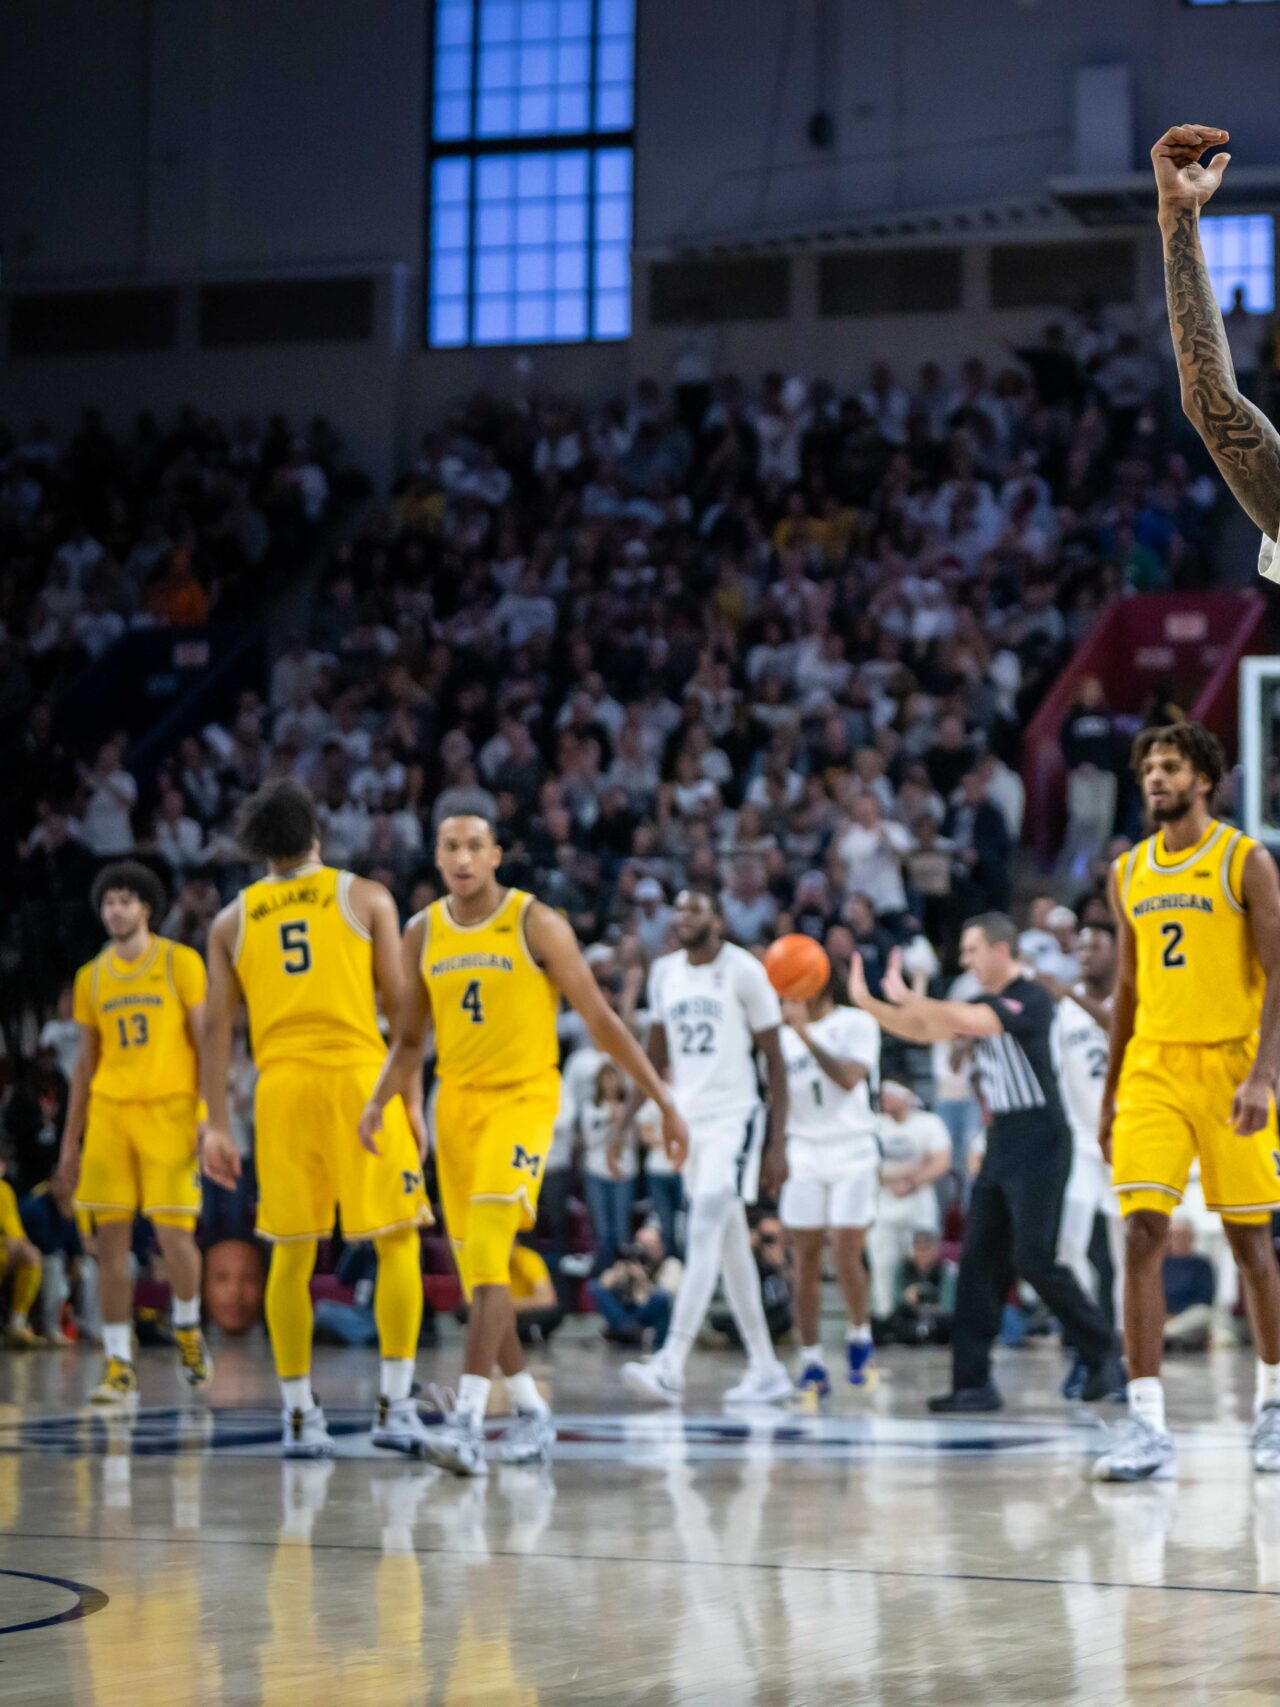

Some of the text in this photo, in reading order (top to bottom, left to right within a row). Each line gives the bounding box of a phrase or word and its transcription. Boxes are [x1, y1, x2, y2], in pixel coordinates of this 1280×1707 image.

[1132, 893, 1213, 918] MICHIGAN
[279, 919, 312, 976] 5
[1160, 921, 1186, 968] 2
[430, 952, 514, 977] MICHIGAN
[461, 979, 485, 1024] 4
[117, 1013, 149, 1049] 13
[678, 1022, 716, 1054] 22
[511, 1144, 540, 1178] M
